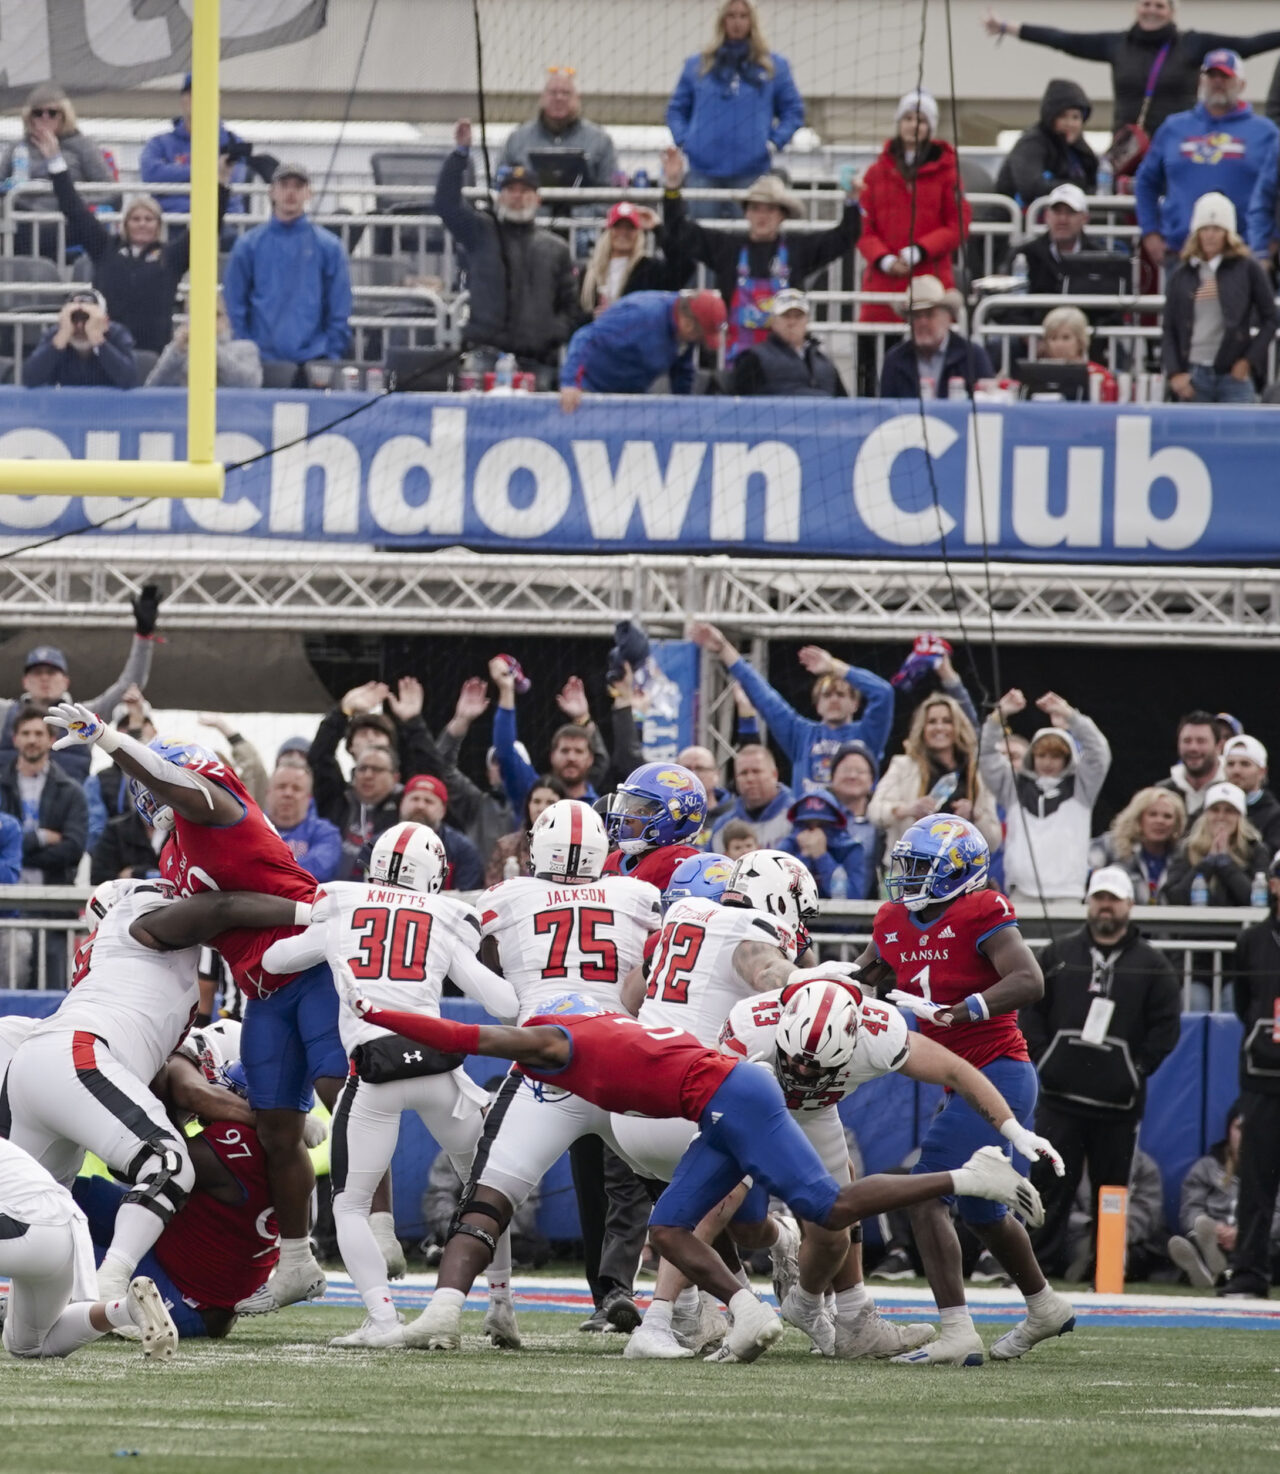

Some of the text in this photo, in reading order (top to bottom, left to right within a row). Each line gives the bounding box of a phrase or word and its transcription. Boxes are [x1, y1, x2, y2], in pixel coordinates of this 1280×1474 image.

[853, 413, 1213, 550] Club
[366, 889, 427, 908] KNOTTS
[546, 888, 606, 907] JACKSON
[995, 895, 1012, 917] 1
[348, 907, 434, 981] 30
[534, 906, 619, 984] 75
[900, 948, 950, 964] KANSAS
[910, 964, 932, 1000] 1
[751, 1001, 780, 1027] 43
[858, 1004, 889, 1037] 43
[216, 1128, 254, 1161] 97
